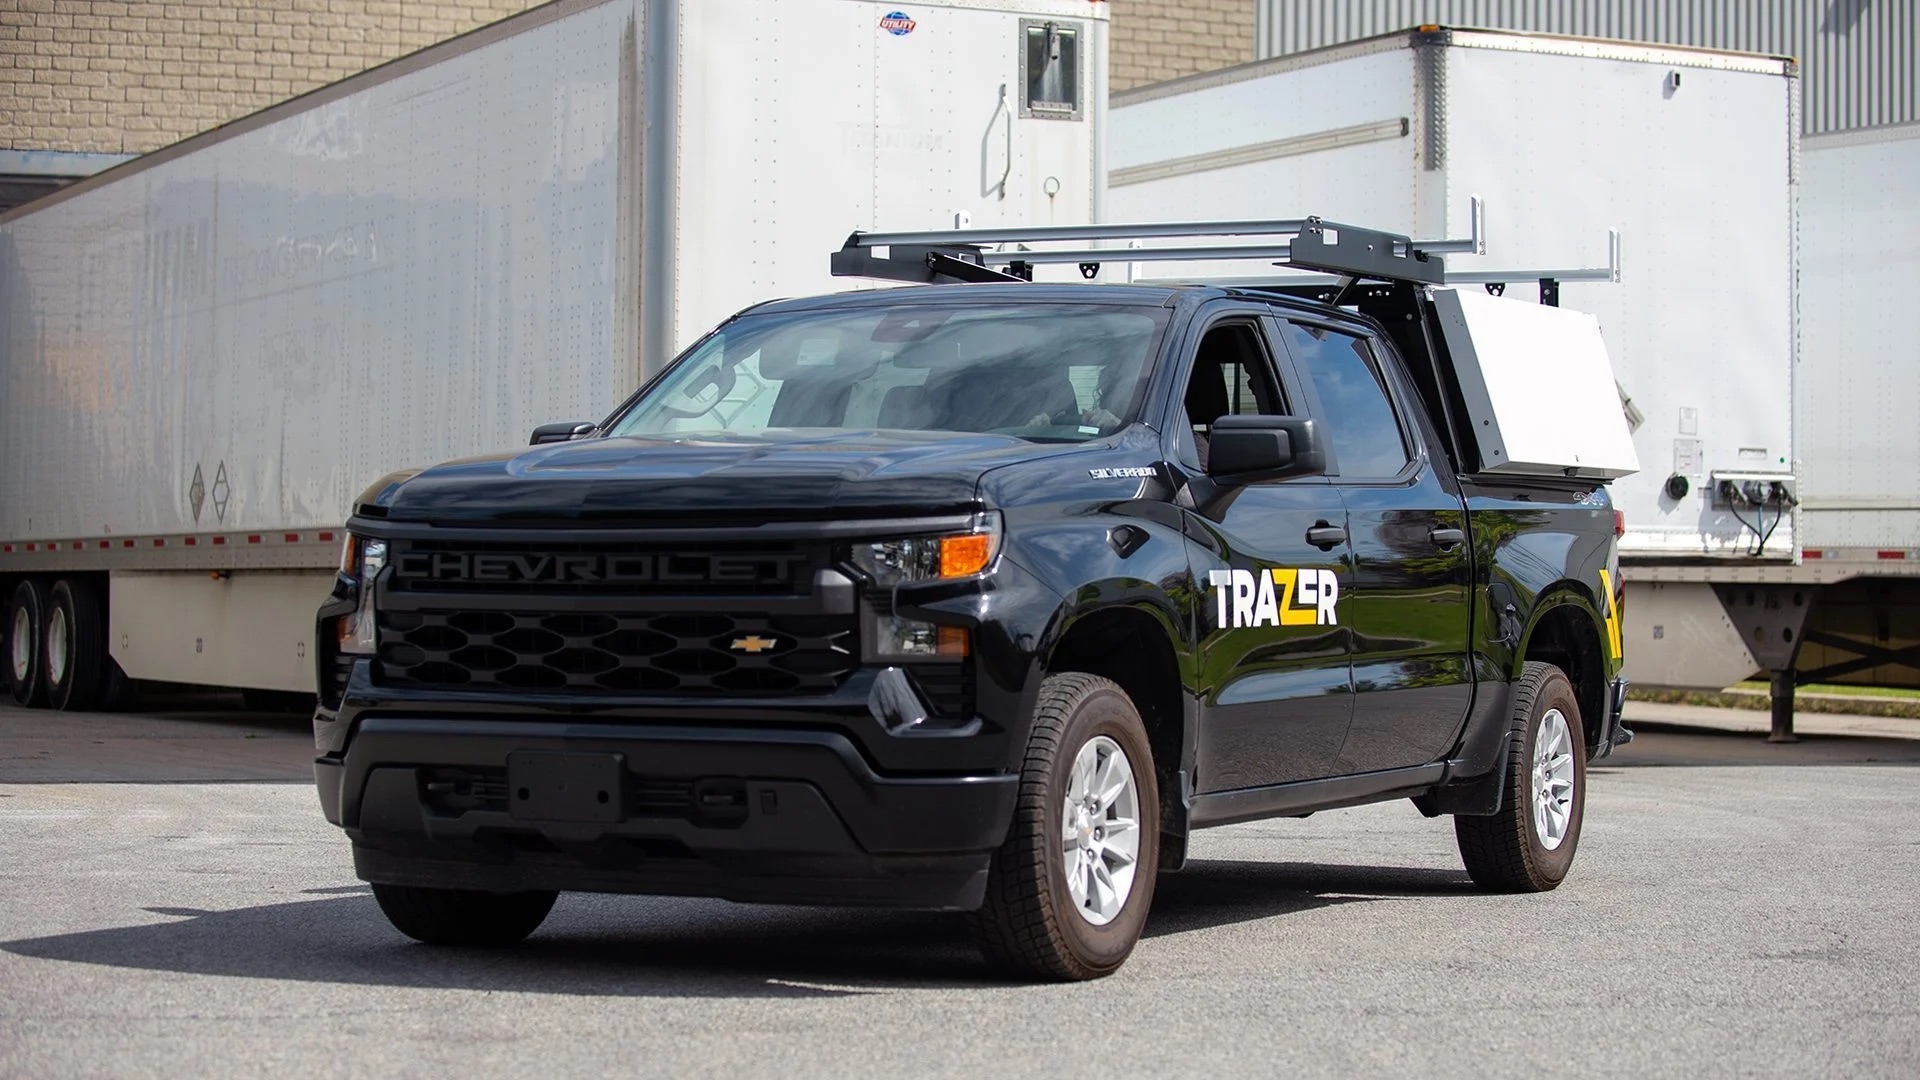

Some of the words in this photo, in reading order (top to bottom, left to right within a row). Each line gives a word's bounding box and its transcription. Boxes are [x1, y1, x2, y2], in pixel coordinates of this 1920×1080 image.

[881, 19, 914, 30] UTILITY
[1089, 467, 1157, 479] SILVERADO
[397, 553, 806, 581] CHEVROLET
[1209, 568, 1339, 629] TRAZER
